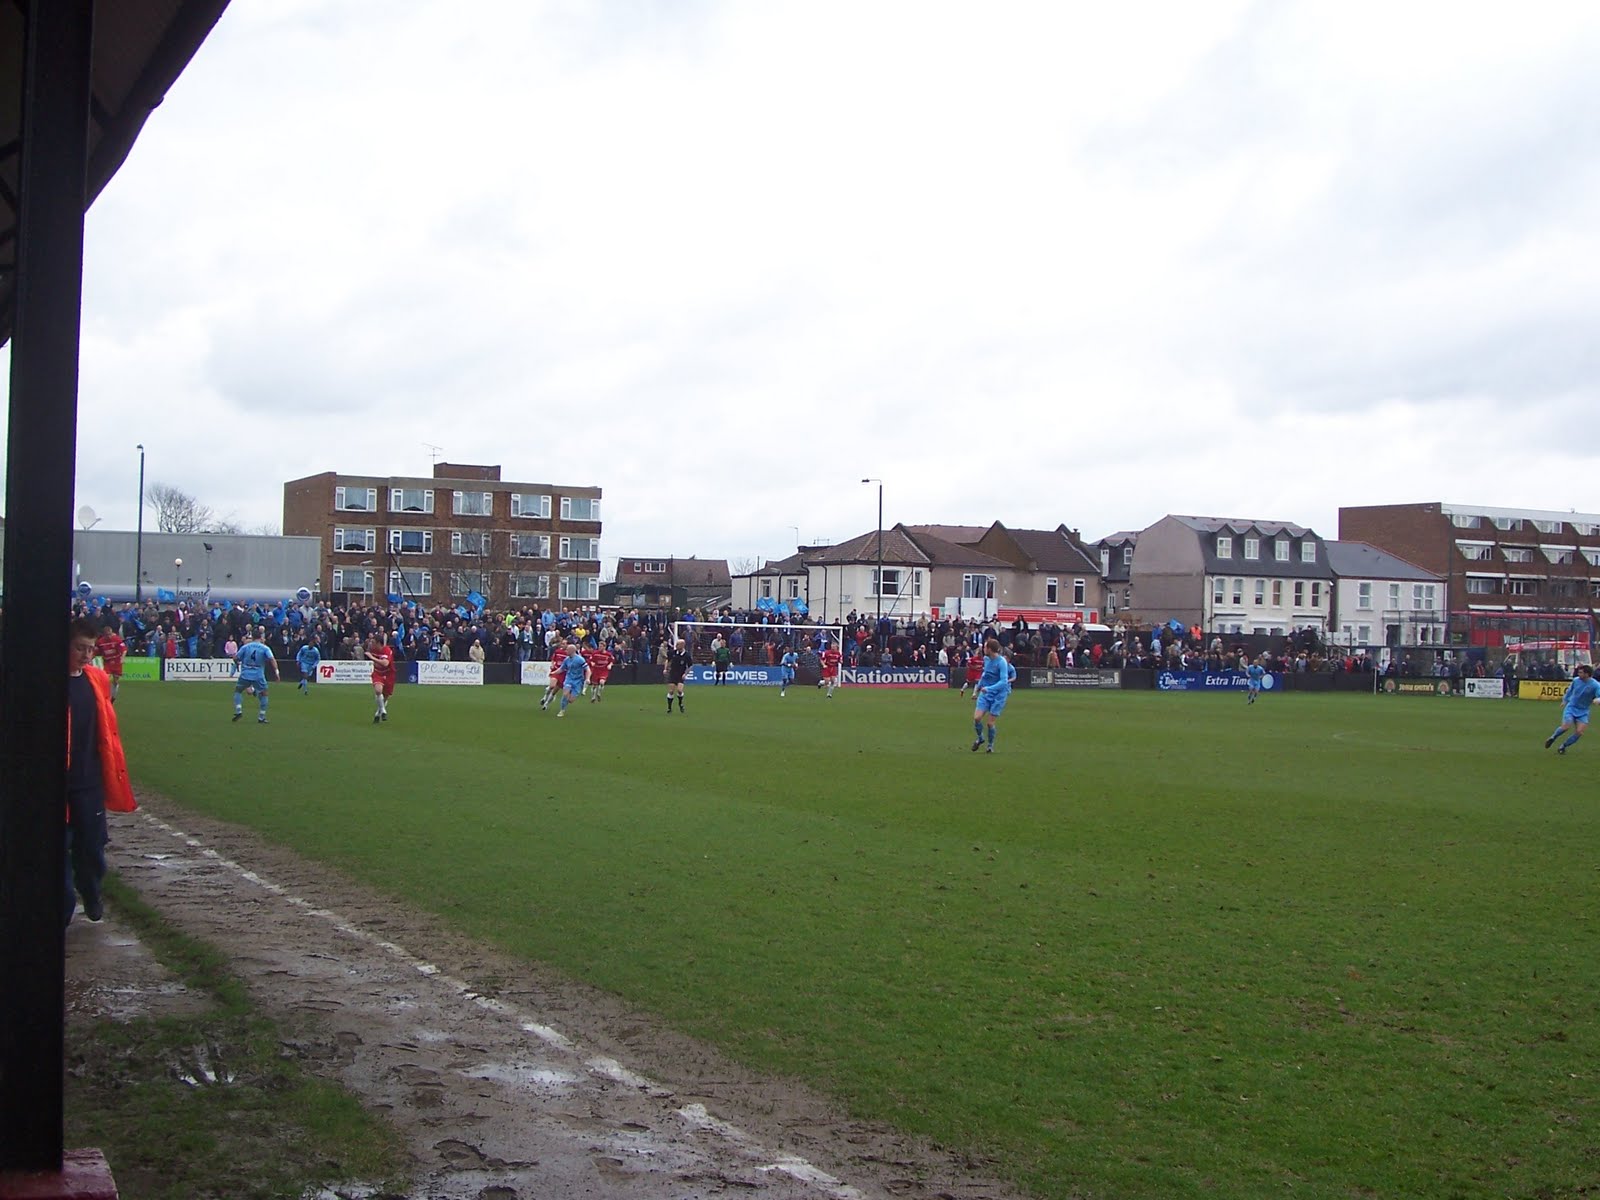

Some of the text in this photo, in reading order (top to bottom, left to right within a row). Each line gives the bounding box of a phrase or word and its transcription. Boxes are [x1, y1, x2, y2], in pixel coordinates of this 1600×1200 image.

[250, 650, 257, 661] 4
[167, 662, 214, 673] BEXLEY
[325, 668, 330, 676] 7
[841, 669, 947, 683] Nationwide
[1205, 676, 1229, 685] Extra
